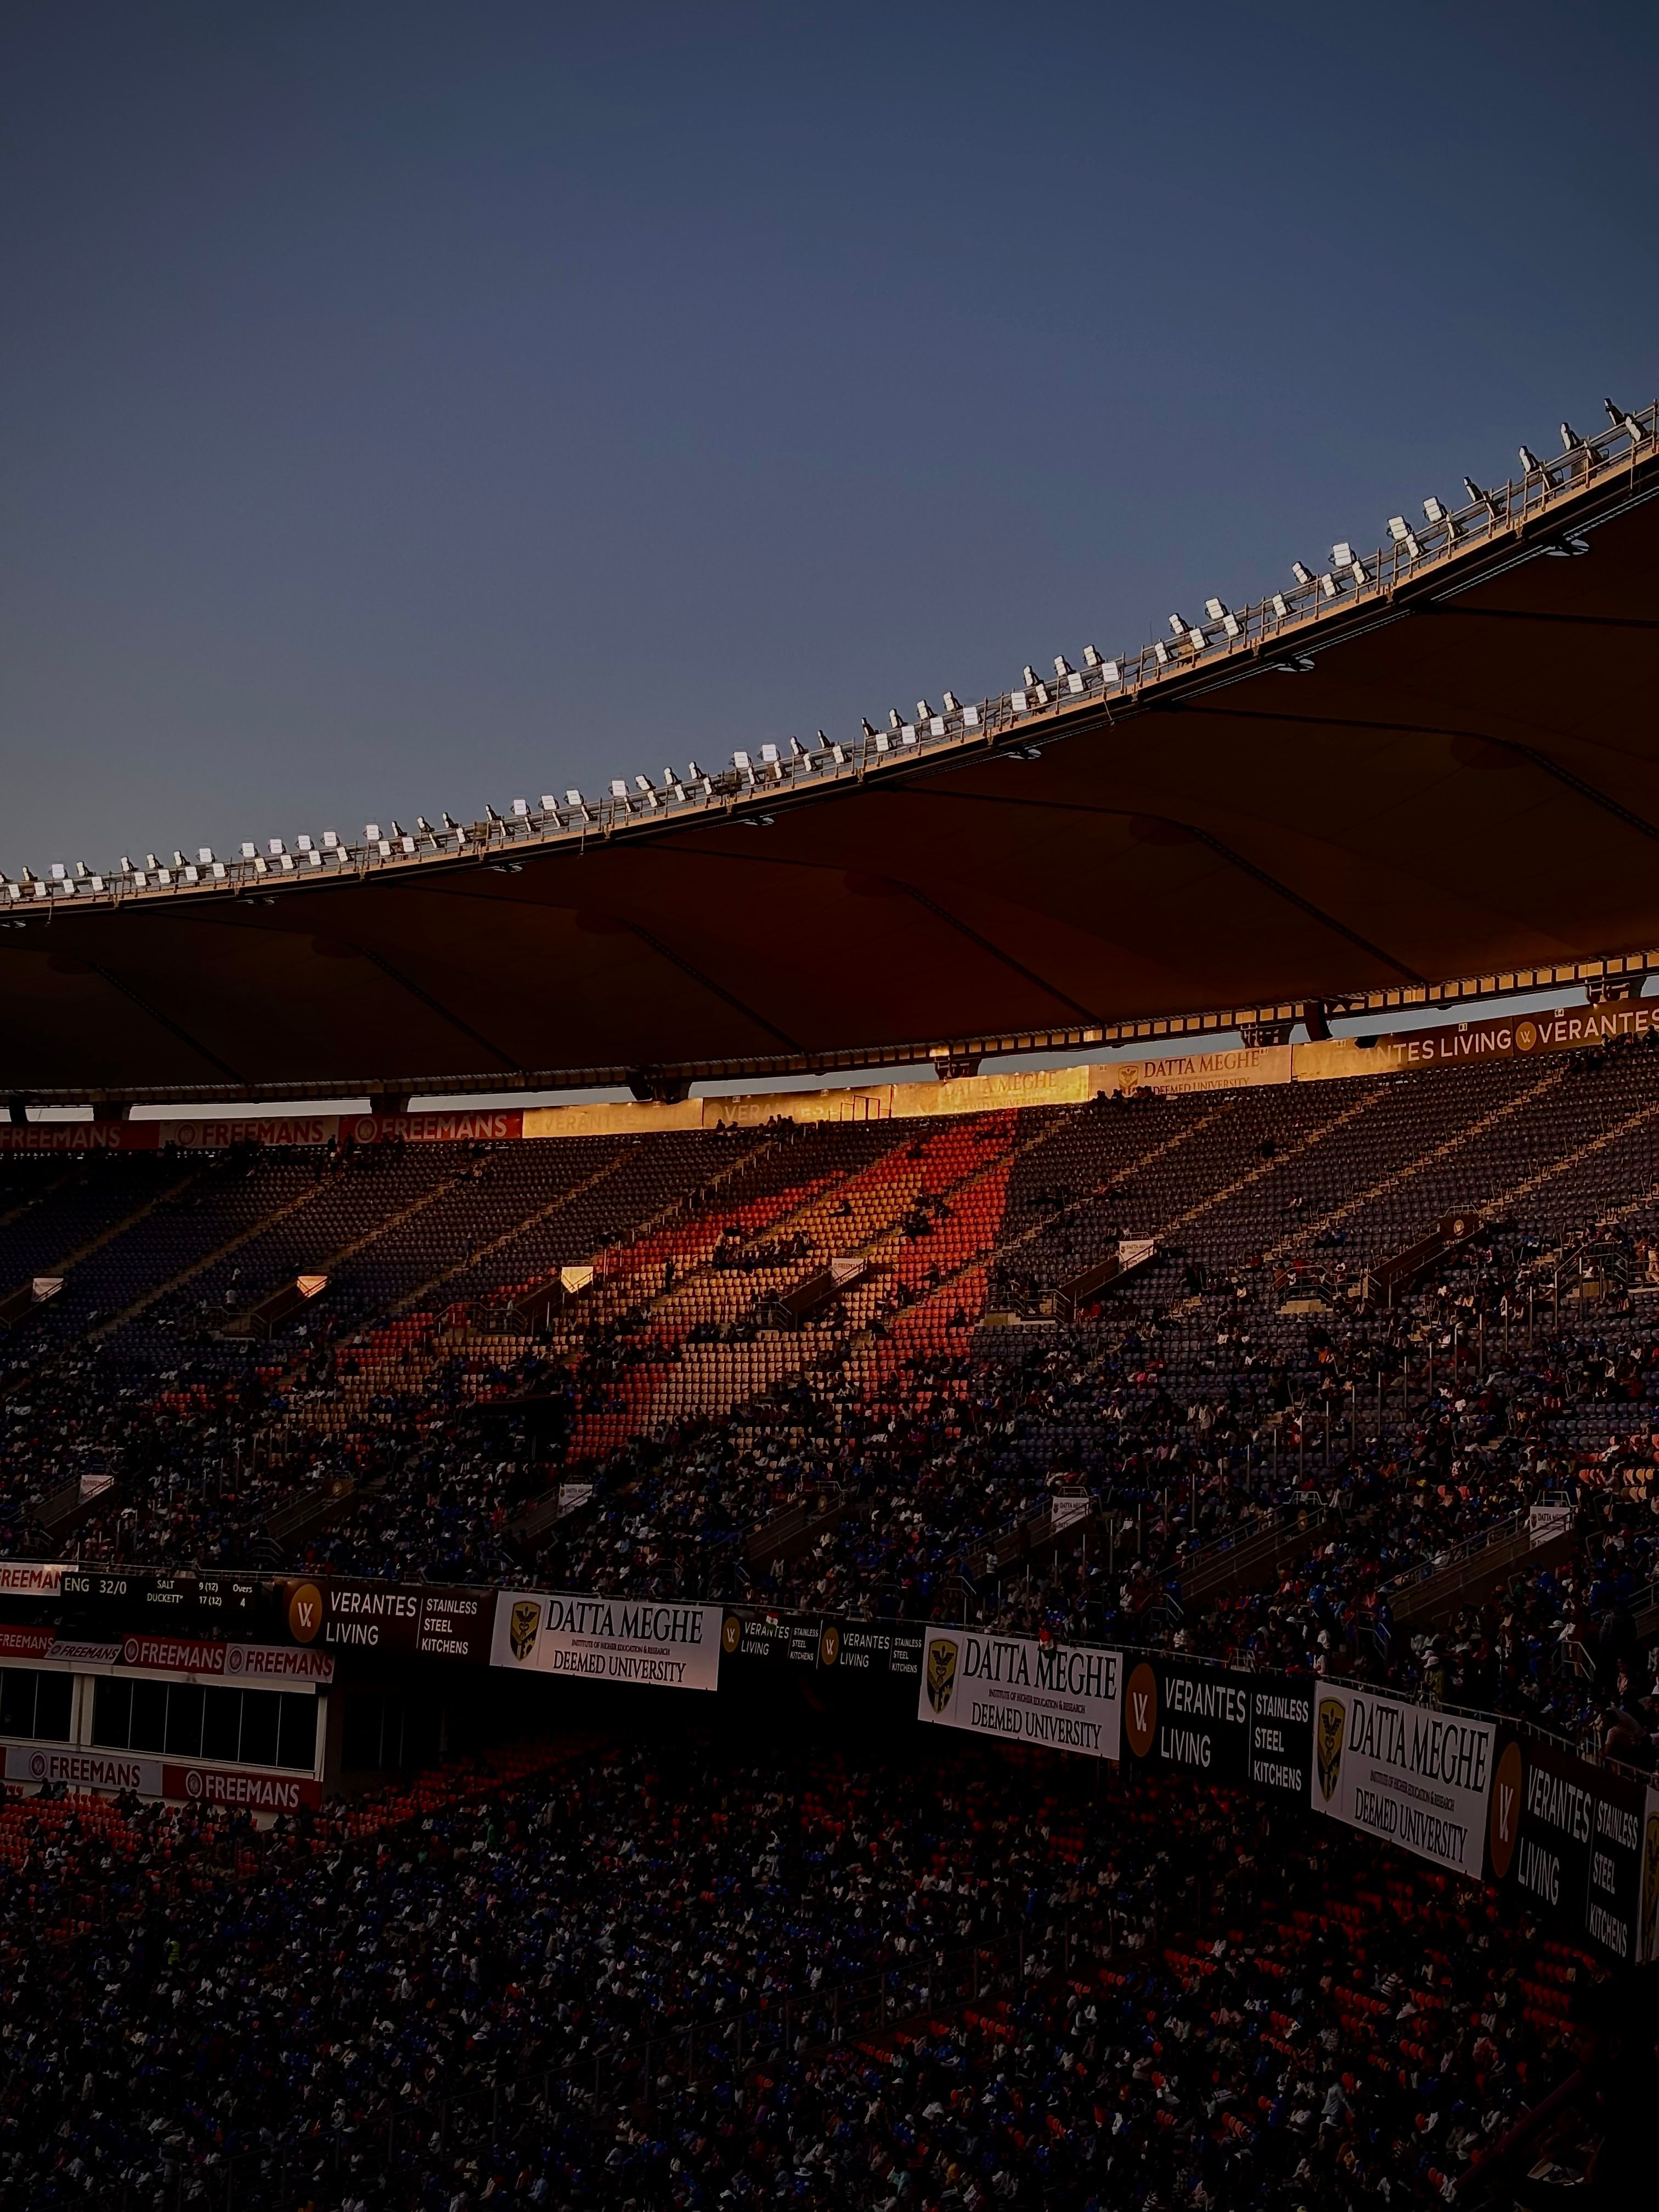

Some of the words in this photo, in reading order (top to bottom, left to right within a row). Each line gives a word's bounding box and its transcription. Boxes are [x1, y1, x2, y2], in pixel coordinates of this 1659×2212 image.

[1538, 1008, 1659, 1043] VERANTES
[1440, 1029, 1511, 1058] LIVING
[1144, 1057, 1195, 1079] DATTA
[1200, 1050, 1260, 1073] MEGHE
[999, 1073, 1057, 1092] MEGHE
[0, 1125, 121, 1148] FREEMANS
[202, 1120, 324, 1146] FREEMANS
[382, 1114, 507, 1141] FREEMANS
[0, 1568, 61, 1589] REEMAN
[64, 1577, 89, 1593] ENG
[99, 1579, 127, 1595] 32/0
[157, 1579, 175, 1589] SALT
[205, 1582, 218, 1593] (12)
[233, 1584, 252, 1593] Overs
[199, 1596, 207, 1605] 17
[208, 1596, 222, 1606] (12)
[240, 1598, 245, 1607] 4
[331, 1592, 417, 1617] VERANTES
[426, 1598, 477, 1615] STAINLESS
[326, 1622, 379, 1645] LIVING
[424, 1618, 453, 1633] STEEL
[546, 1600, 615, 1636] DATTA
[619, 1605, 703, 1644] MEGHE
[793, 1627, 819, 1637] STAINLESS
[60, 1645, 119, 1660] FREEMANS
[421, 1638, 469, 1655] KITCHENS
[741, 1640, 769, 1655] LIVING
[792, 1639, 807, 1649] STEEL
[843, 1633, 890, 1650] VERANTES
[895, 1638, 922, 1648] STAINLESS
[140, 1642, 224, 1670] FREEMANS
[246, 1650, 334, 1677] FREEMANS
[553, 1650, 605, 1674] DEEMED
[609, 1656, 686, 1683] UNIVERSITY
[790, 1650, 814, 1661] KITCHENS
[840, 1652, 869, 1668] LIVING
[891, 1662, 917, 1673] KITCHENS
[893, 1650, 909, 1660] STEEL
[962, 1638, 1030, 1686] DATTA
[1034, 1645, 1117, 1700] MEGHE
[1165, 1677, 1246, 1723] VERANTES
[1256, 1694, 1308, 1723] STAINLESS
[971, 1702, 1022, 1733] DEEMED
[1025, 1711, 1102, 1749] UNIVERSITY
[1161, 1726, 1211, 1768] LIVING
[1255, 1726, 1284, 1752] STEEL
[1348, 1699, 1406, 1768] DATTA
[1409, 1714, 1489, 1793] MEGHE
[50, 1757, 141, 1788] FREEMANS
[1254, 1760, 1301, 1791] KITCHENS
[205, 1774, 300, 1807] FREEMANS
[1527, 1764, 1591, 1843] VERANTES
[1355, 1787, 1397, 1833] DEEMED
[1400, 1804, 1468, 1863] UNIVERSITY
[1597, 1800, 1638, 1850] STAINLESS
[1518, 1837, 1559, 1905] LIVING
[1593, 1851, 1616, 1894] STEEL
[1589, 1902, 1628, 1957] KITCHENS
